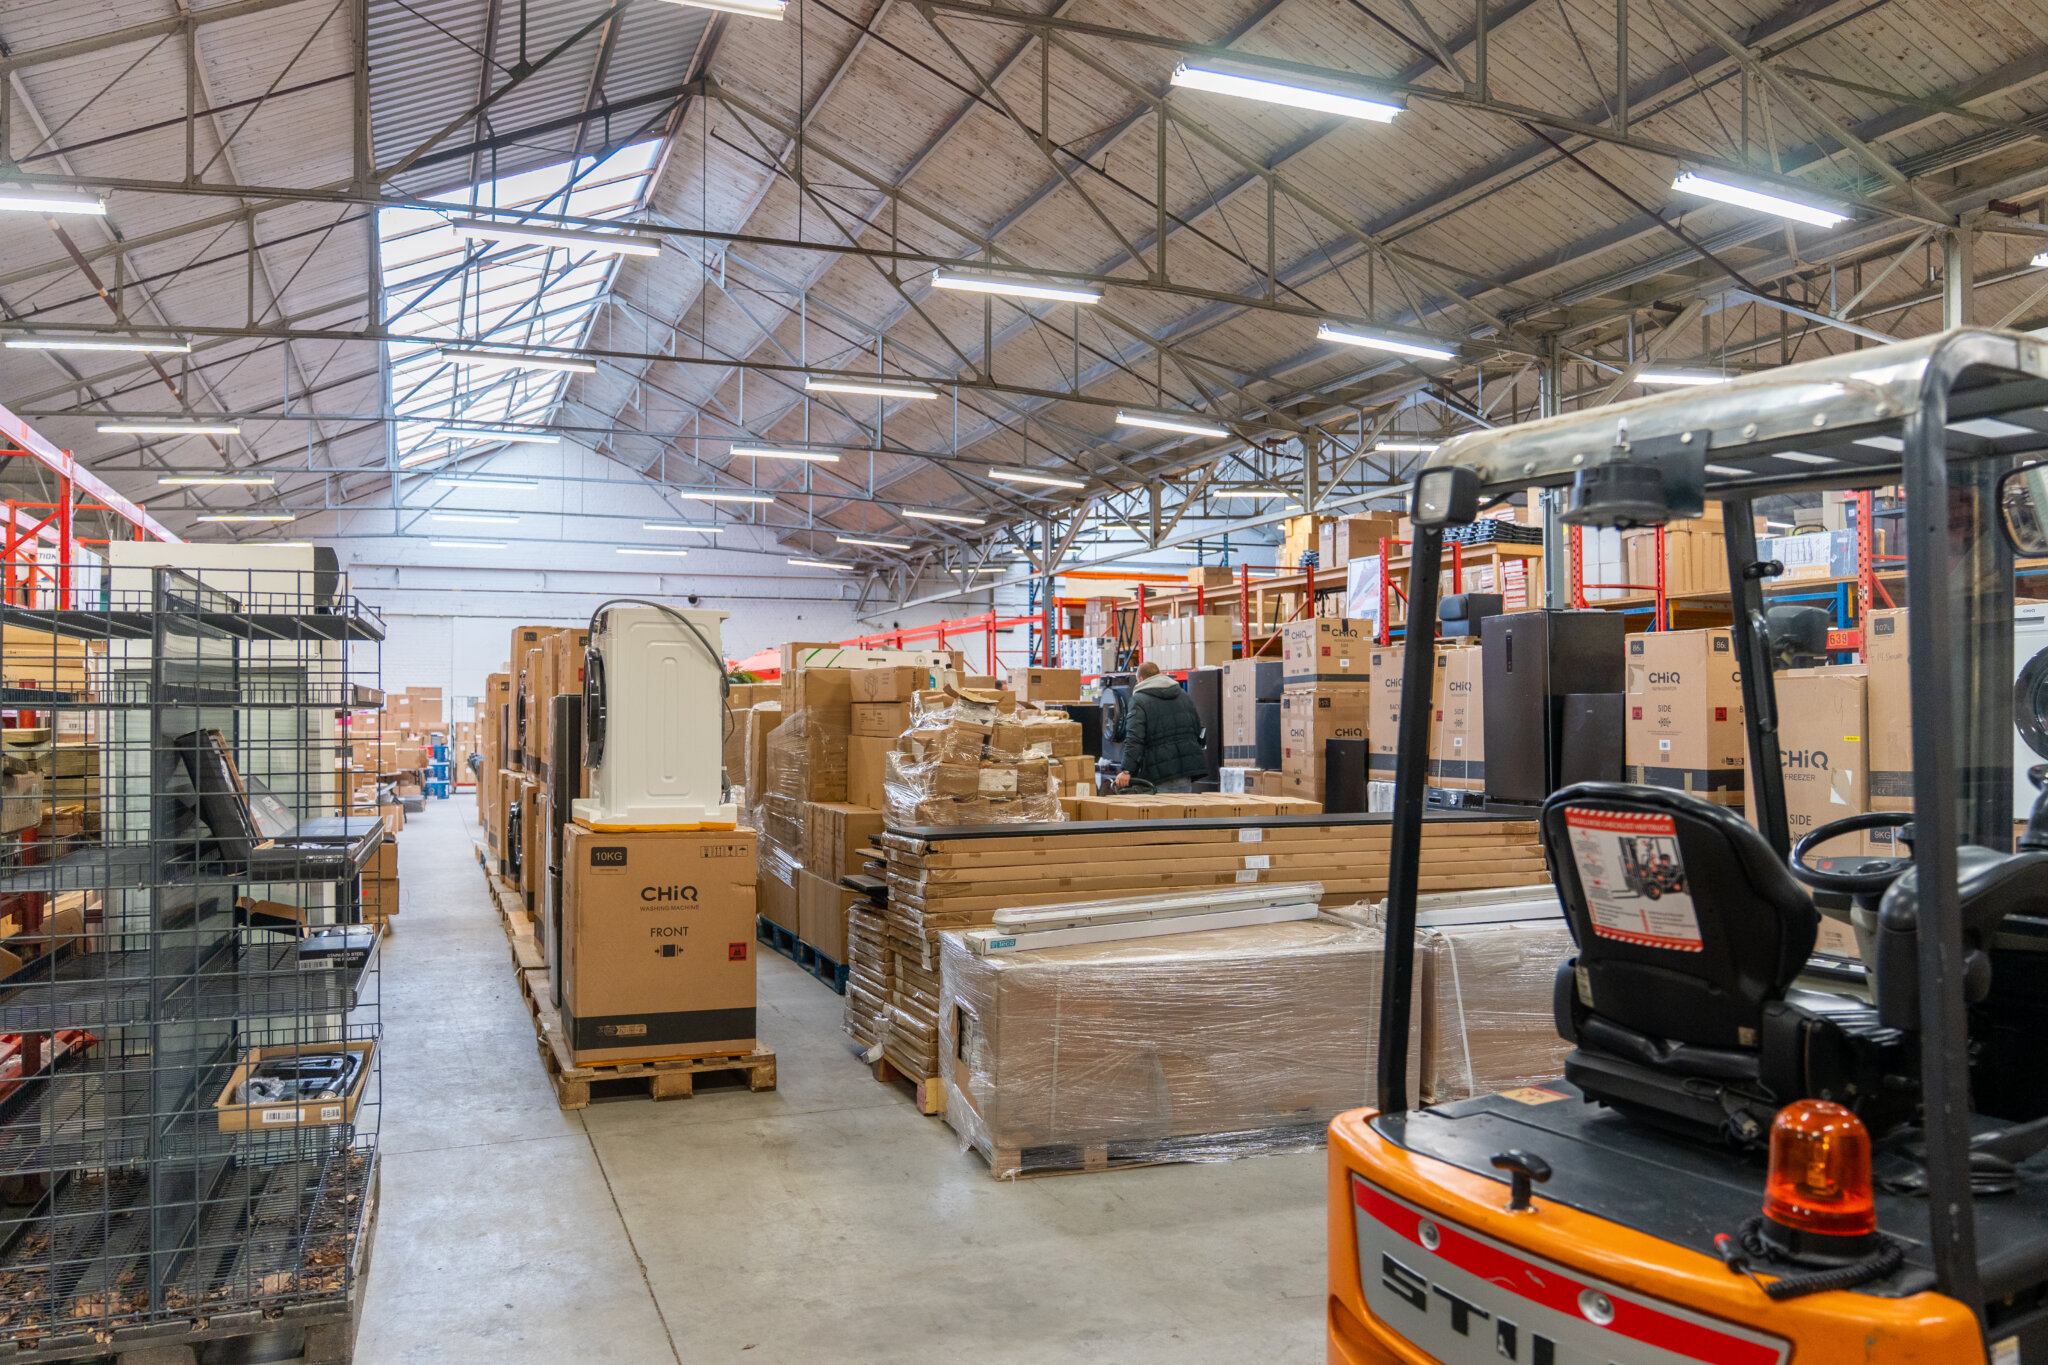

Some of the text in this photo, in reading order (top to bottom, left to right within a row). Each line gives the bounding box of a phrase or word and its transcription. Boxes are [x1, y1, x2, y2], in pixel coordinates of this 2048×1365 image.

[1829, 633, 1847, 645] 639
[1648, 671, 1681, 685] CHiQ
[1449, 681, 1472, 692] CHiQ
[1657, 704, 1672, 713] SIDE
[1334, 727, 1363, 738] CHiQ
[1784, 773, 1816, 782] FREEZER
[1789, 813, 1813, 826] SIDE
[1873, 830, 1892, 840] 9KG
[595, 851, 623, 862] 10KG
[640, 884, 699, 902] CHiQ
[639, 904, 670, 912] WASHING
[650, 926, 689, 938] FRONT
[1382, 1250, 1620, 1365] STI
